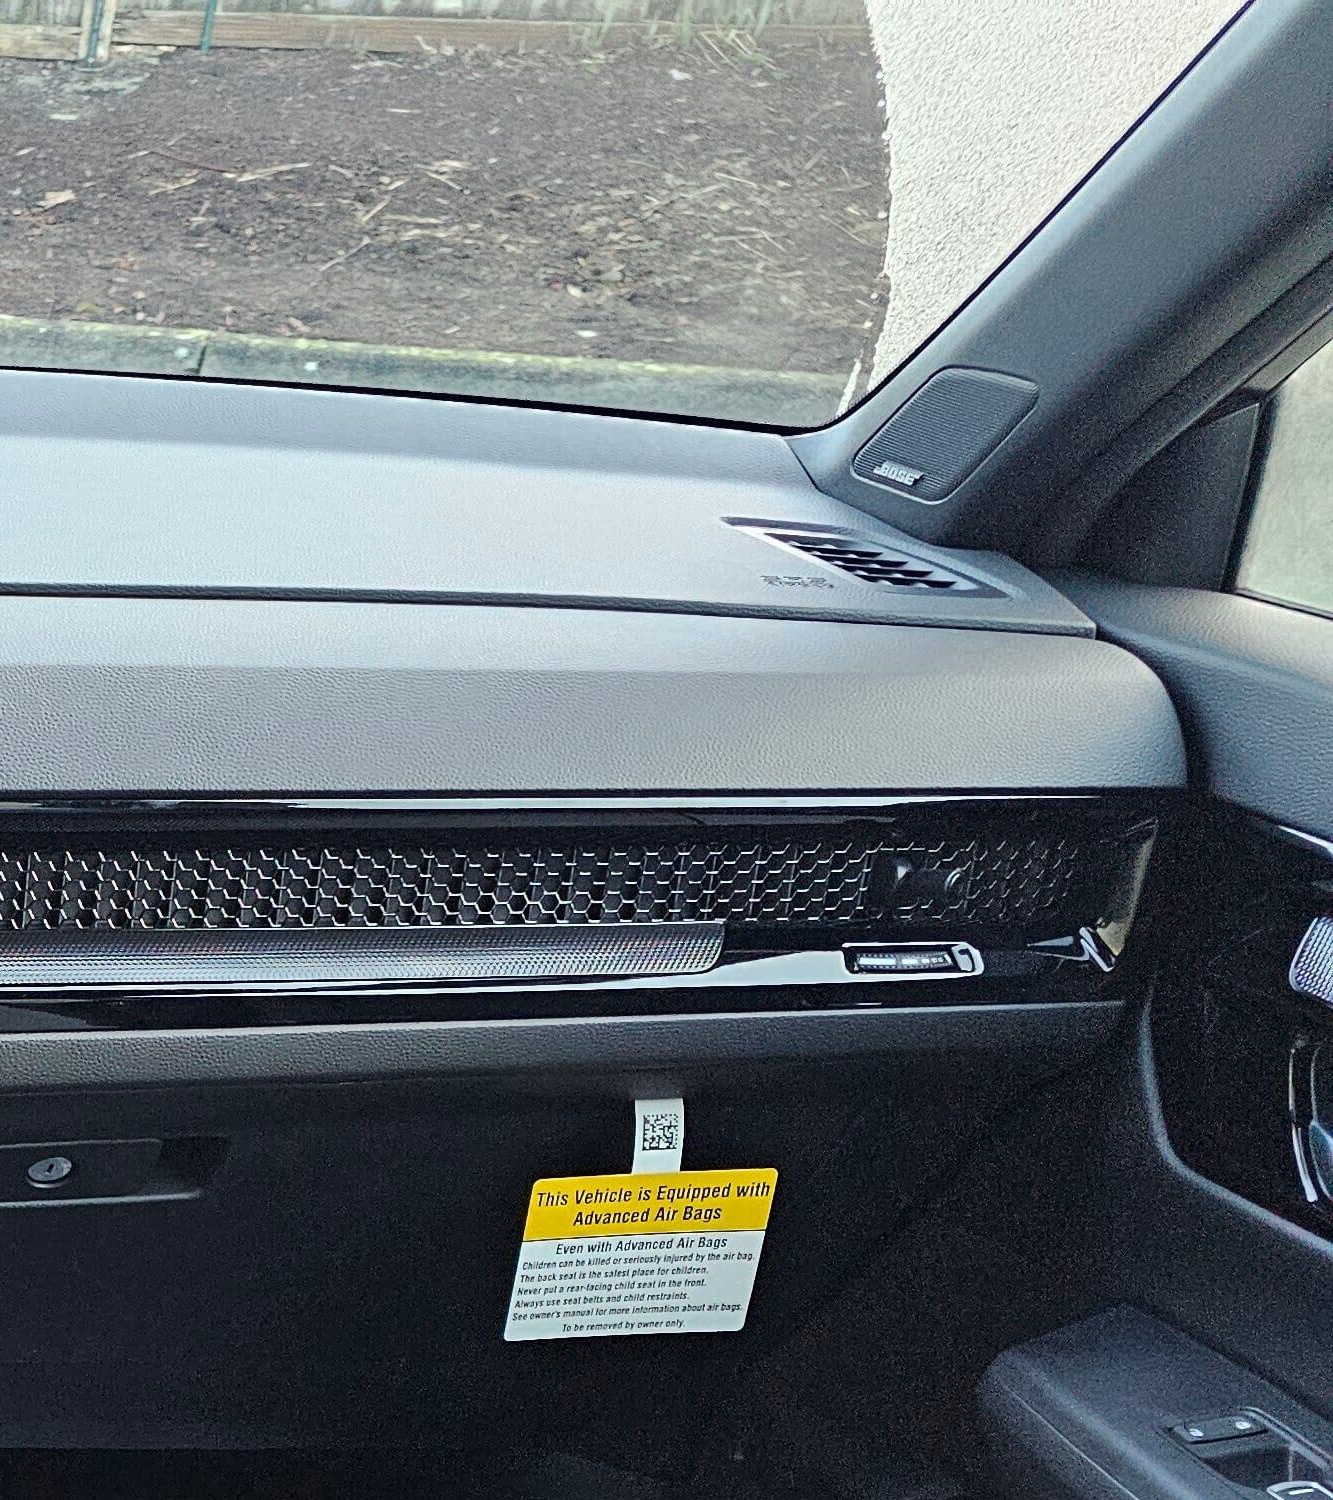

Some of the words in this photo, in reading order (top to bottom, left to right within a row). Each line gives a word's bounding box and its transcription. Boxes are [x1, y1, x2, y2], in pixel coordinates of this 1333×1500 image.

[873, 461, 924, 486] BOSE
[537, 1191, 569, 1207] This
[575, 1188, 632, 1205] Vehicle
[637, 1186, 651, 1201] is
[656, 1182, 732, 1203] Equipped
[736, 1181, 770, 1197] with
[572, 1208, 650, 1227] Advanced
[654, 1206, 678, 1222] Air
[683, 1205, 722, 1222] Bags
[555, 1243, 583, 1255] Even
[587, 1241, 612, 1253] with
[614, 1238, 674, 1252] Advanced
[676, 1237, 695, 1249] Air
[698, 1236, 728, 1249] Bags
[522, 1261, 557, 1271] Children
[558, 1260, 573, 1268] can
[575, 1259, 586, 1267] be
[587, 1257, 611, 1266] killed
[623, 1255, 661, 1264] seriously
[663, 1254, 693, 1263] injured
[695, 1253, 705, 1262] by
[707, 1253, 721, 1261] the
[723, 1252, 736, 1260] air
[736, 1251, 755, 1262] bag.
[520, 1274, 535, 1283] The
[537, 1273, 556, 1282] back
[558, 1271, 577, 1280] seat
[578, 1271, 586, 1279] is
[588, 1270, 602, 1278] the
[604, 1268, 630, 1278] safest
[631, 1268, 655, 1278] place
[657, 1267, 669, 1275] for
[671, 1265, 709, 1275] children.
[517, 1287, 541, 1296] Never
[543, 1286, 558, 1295] put
[566, 1283, 612, 1293] rear-facing
[614, 1281, 635, 1290] child
[637, 1280, 656, 1289] seat
[657, 1280, 666, 1288] in
[668, 1279, 682, 1287] the
[684, 1278, 707, 1287] front.
[514, 1299, 544, 1309] Always
[546, 1299, 561, 1307] use
[563, 1297, 581, 1306] seat
[583, 1295, 604, 1305] belts
[605, 1294, 622, 1303] and
[623, 1292, 645, 1302] child
[646, 1292, 689, 1301] restraints.
[512, 1313, 527, 1321] See
[529, 1311, 561, 1320] owner's
[562, 1308, 594, 1318] manual
[595, 1307, 608, 1316] for
[608, 1307, 630, 1315] more
[632, 1304, 680, 1314] information
[681, 1303, 705, 1312] about
[706, 1303, 719, 1311] air
[721, 1302, 743, 1312] bags.
[562, 1323, 572, 1332] To
[573, 1323, 584, 1331] be
[586, 1321, 623, 1331] removed
[624, 1320, 635, 1330] by
[637, 1320, 663, 1328] owner
[665, 1319, 685, 1328] only.
